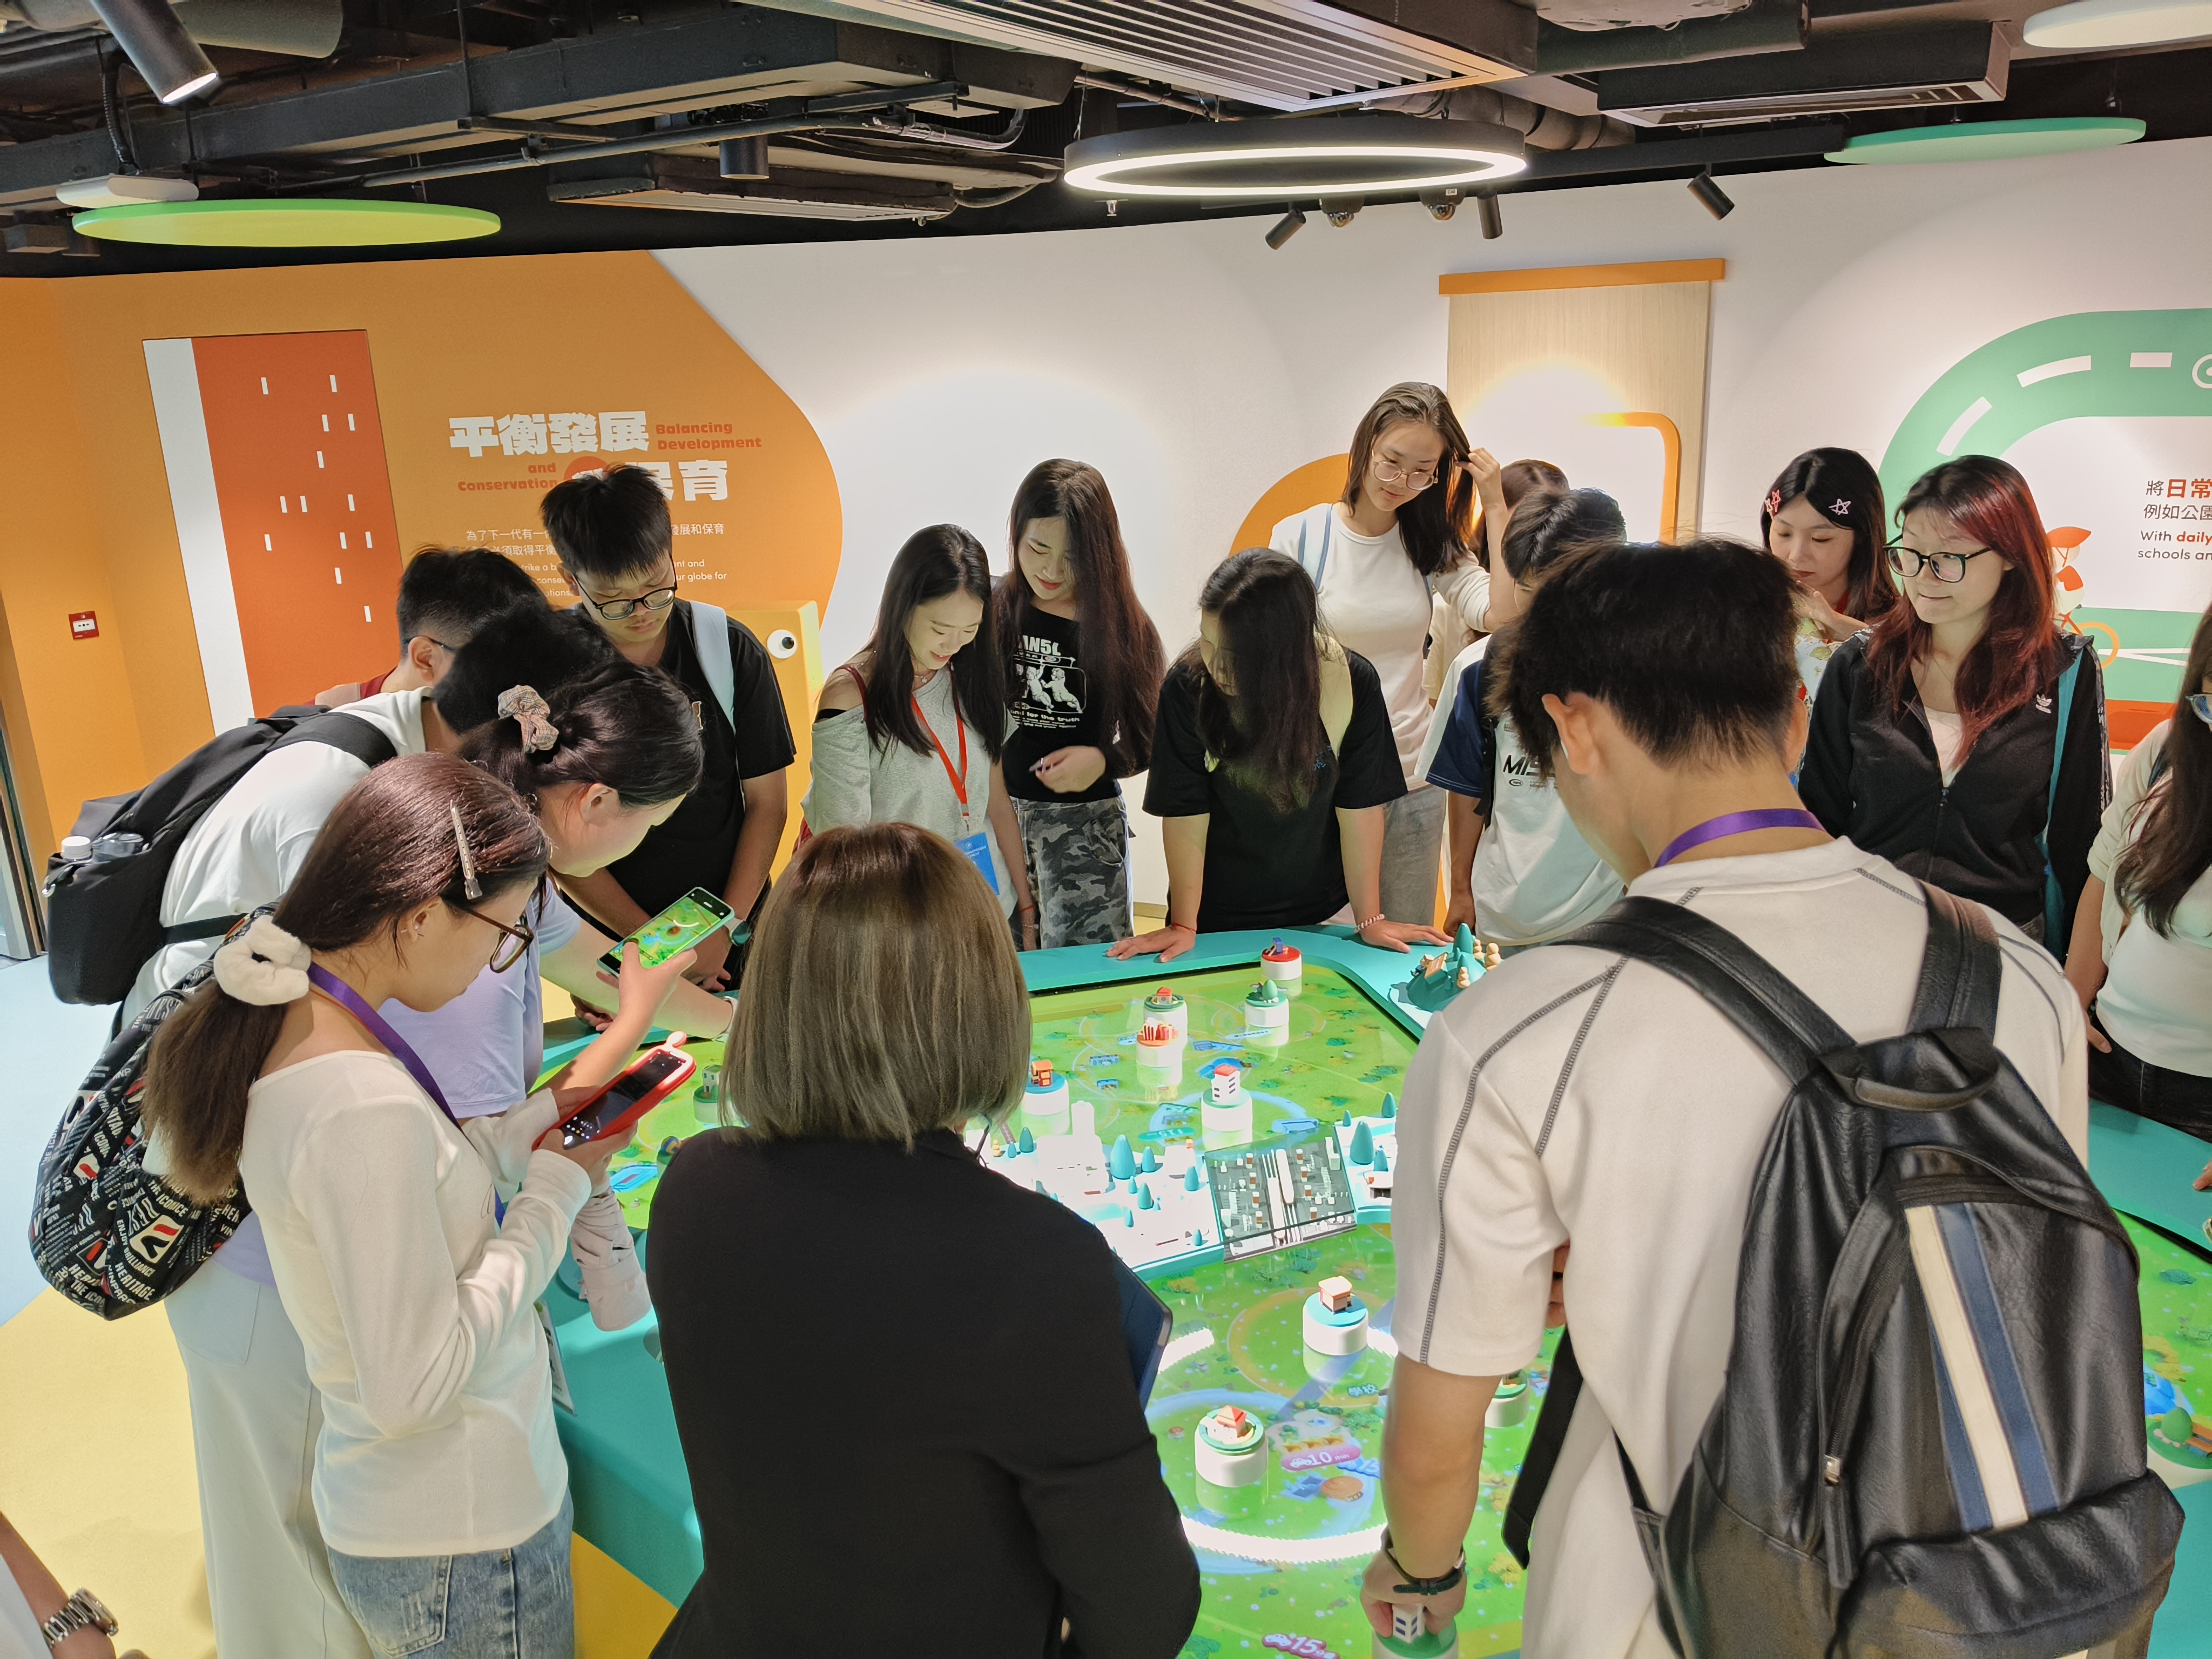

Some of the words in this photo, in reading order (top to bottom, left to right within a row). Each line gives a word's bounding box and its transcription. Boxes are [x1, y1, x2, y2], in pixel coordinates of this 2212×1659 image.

[449, 410, 649, 457] 平衡發展
[655, 422, 733, 435] Balancing
[657, 437, 762, 450] Development
[528, 462, 557, 474] and
[457, 478, 558, 491] Conservation
[2140, 530, 2172, 542] With
[2176, 531, 2212, 546] daily
[2137, 548, 2190, 560] schools
[687, 558, 705, 568] and
[687, 571, 712, 583] globe
[714, 571, 727, 580] for
[1310, 1452, 1333, 1466] 10
[1291, 1636, 1324, 1654] 15
